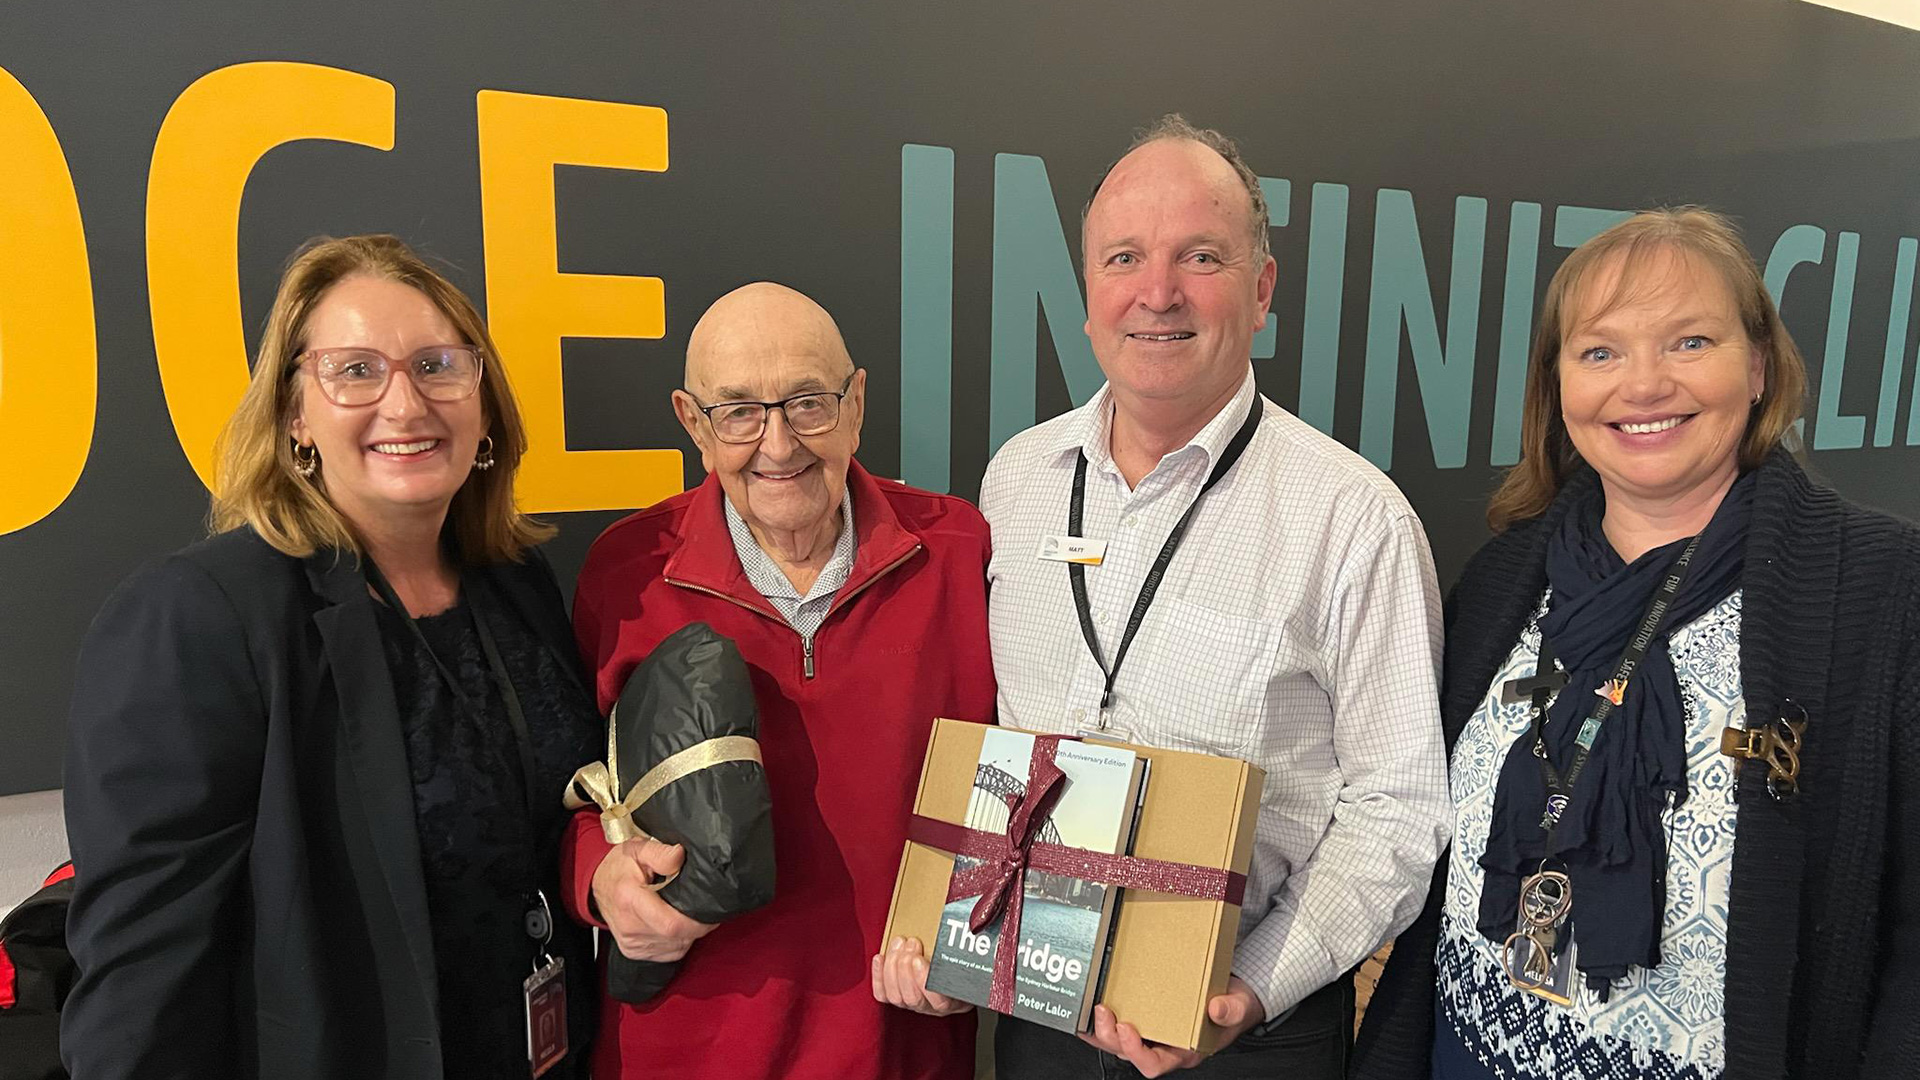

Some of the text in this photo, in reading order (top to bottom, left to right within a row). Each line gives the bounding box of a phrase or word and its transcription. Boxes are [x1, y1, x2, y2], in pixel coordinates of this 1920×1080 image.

[1663, 575, 1680, 593] FUN
[1632, 599, 1667, 652] INNOVATION
[1067, 751, 1103, 764] Anniversary
[1104, 758, 1127, 767] Edition
[946, 918, 1082, 984] The ridge
[1523, 969, 1554, 987] MELISA
[1017, 993, 1072, 1019] Peter Lalor
